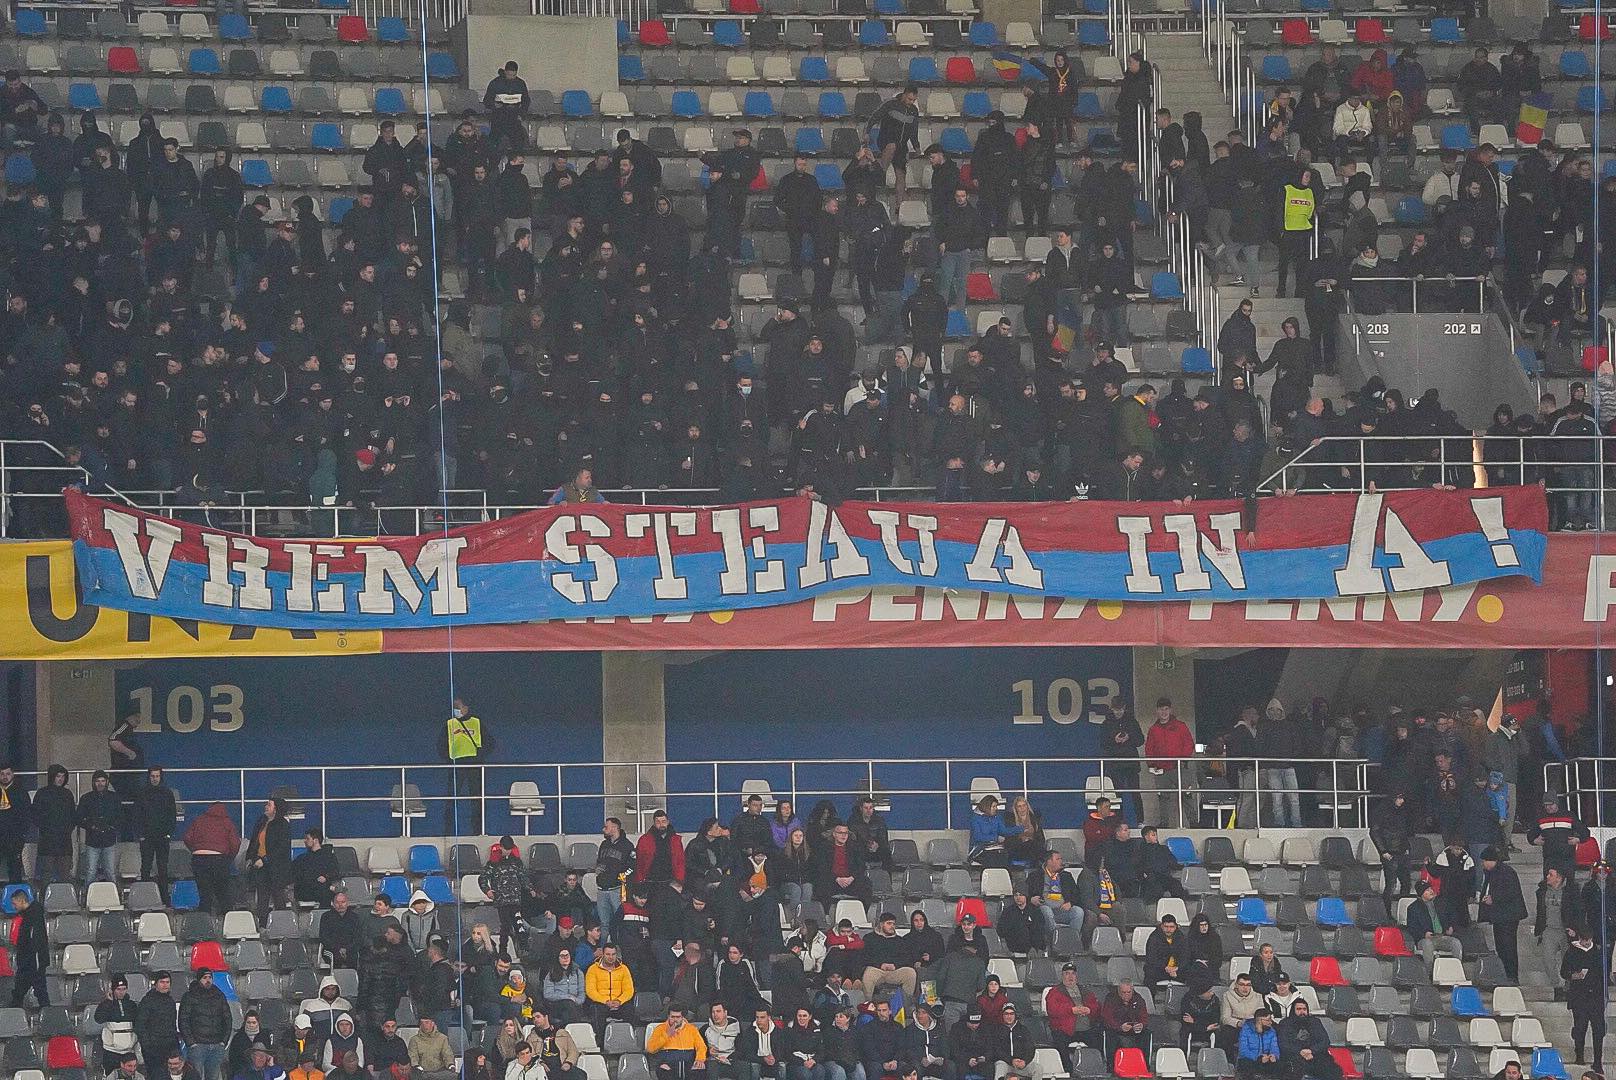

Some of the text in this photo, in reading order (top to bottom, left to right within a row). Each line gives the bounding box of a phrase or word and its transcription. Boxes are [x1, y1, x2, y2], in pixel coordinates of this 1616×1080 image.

[1366, 323, 1390, 335] 203
[1443, 323, 1467, 335] 202
[103, 507, 470, 616] VREM
[545, 500, 1045, 604] STEAUA
[1118, 511, 1248, 594] IN
[129, 684, 245, 734] 103
[1012, 677, 1121, 725] 103
